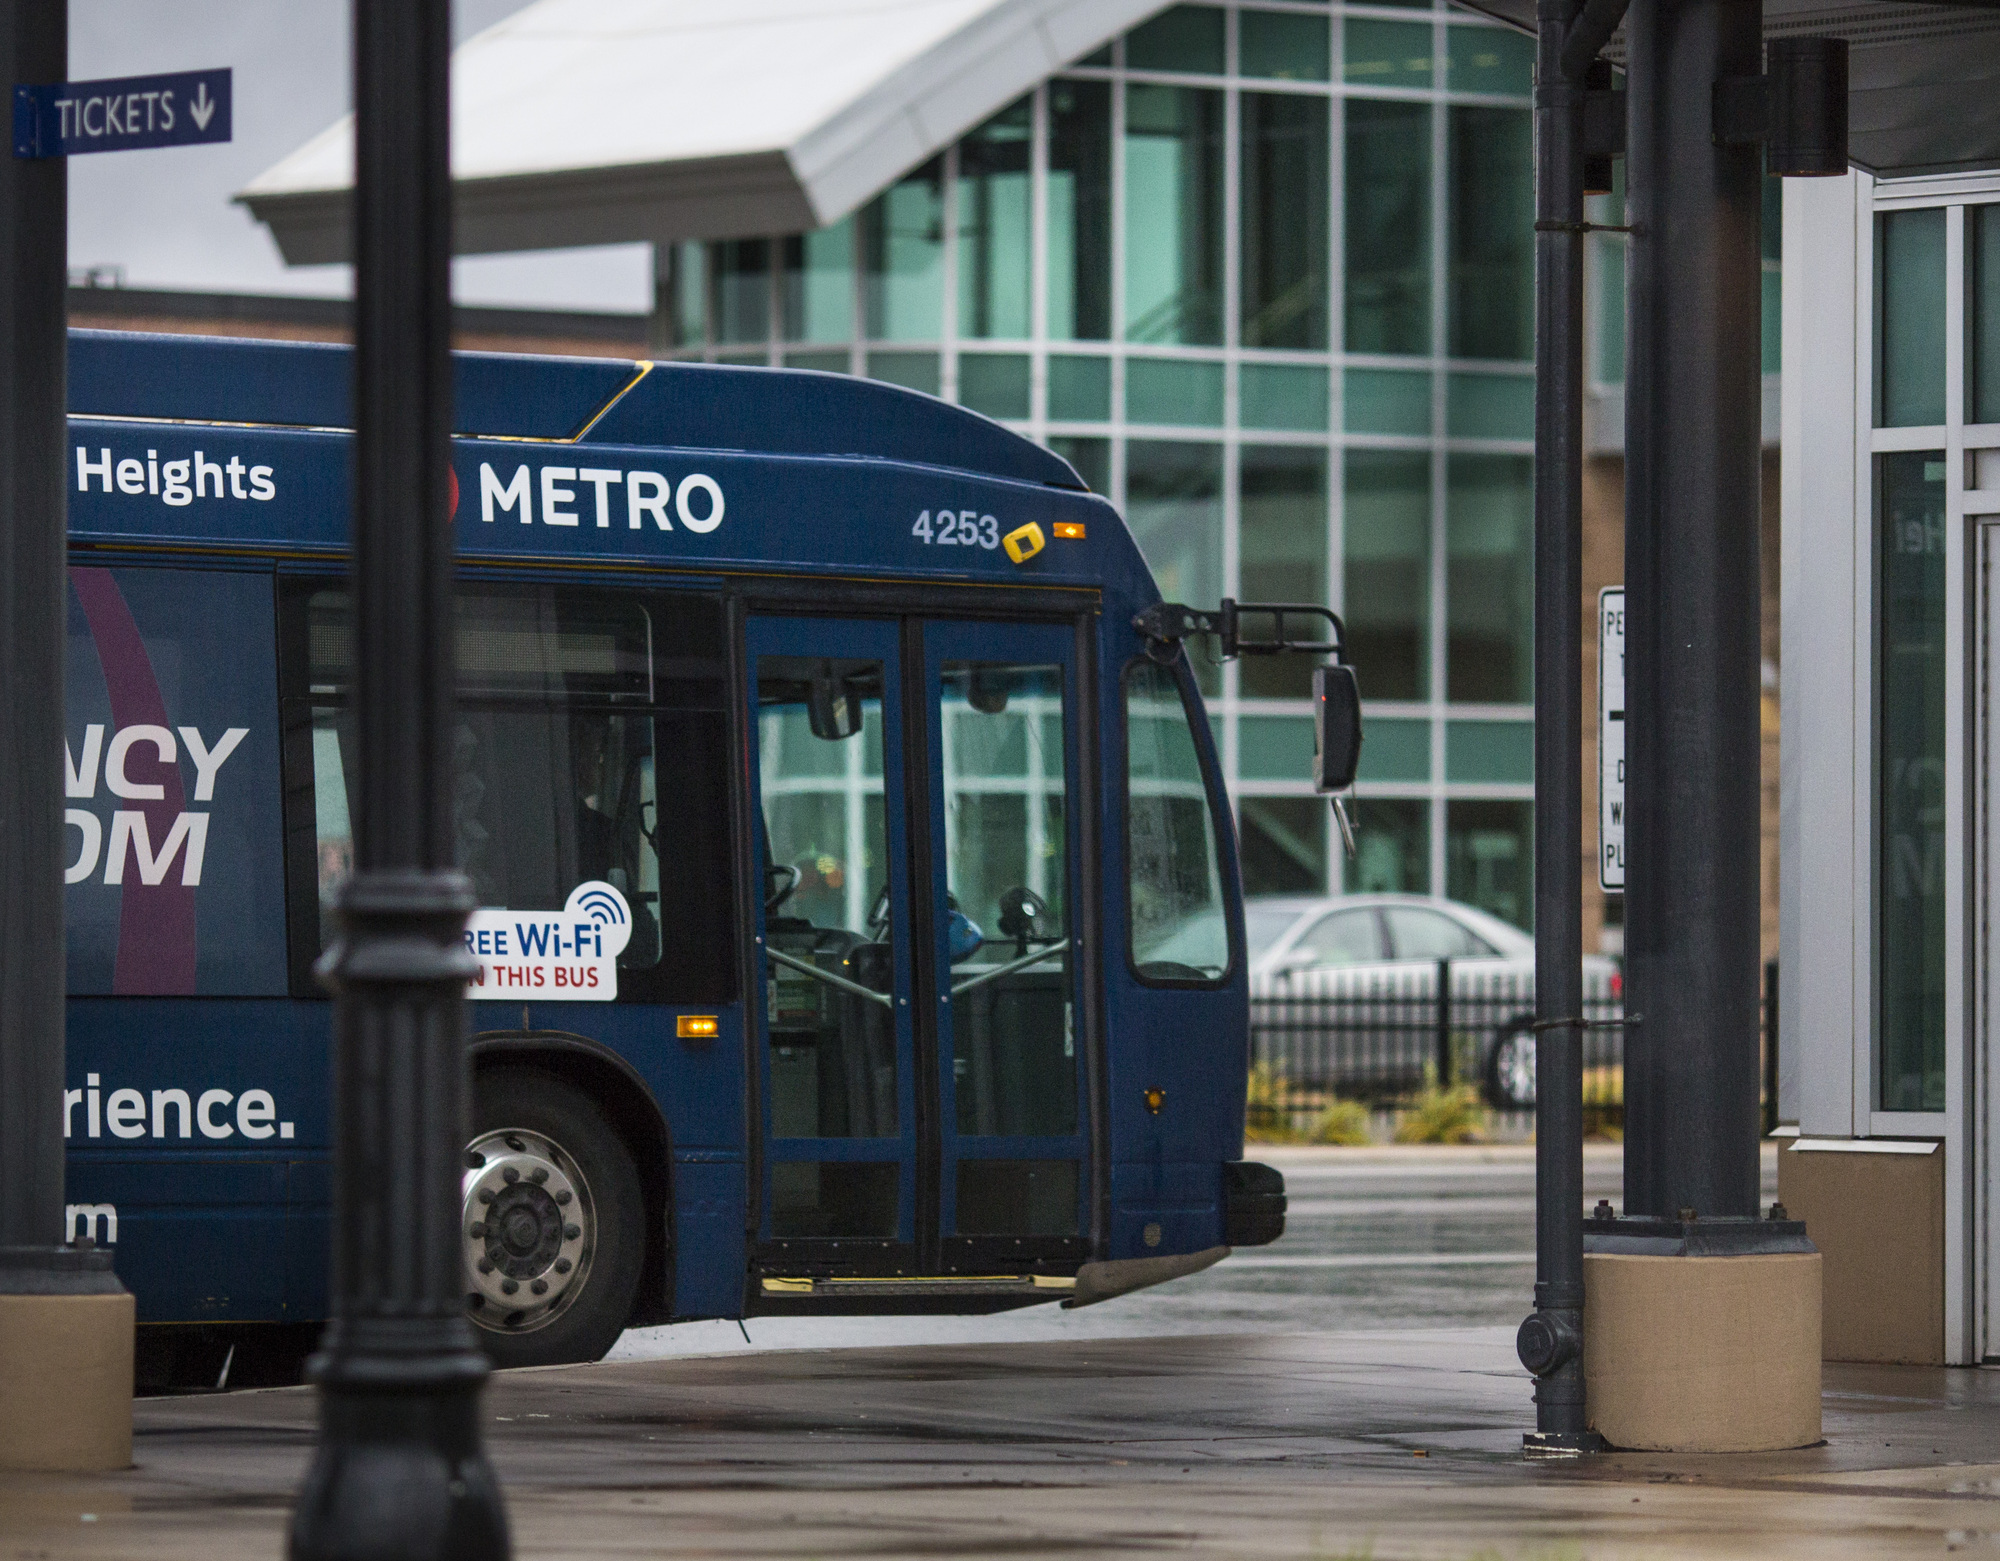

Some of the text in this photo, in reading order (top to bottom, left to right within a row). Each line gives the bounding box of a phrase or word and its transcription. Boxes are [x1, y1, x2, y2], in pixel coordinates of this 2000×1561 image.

[54, 90, 176, 139] TICKETS
[76, 446, 276, 506] Heights
[480, 462, 725, 533] METRO
[912, 510, 999, 550] 4253
[515, 923, 602, 958] Wi-Fi
[493, 965, 545, 988] THIS
[554, 966, 599, 988] BUS
[64, 1072, 295, 1139] rience.
